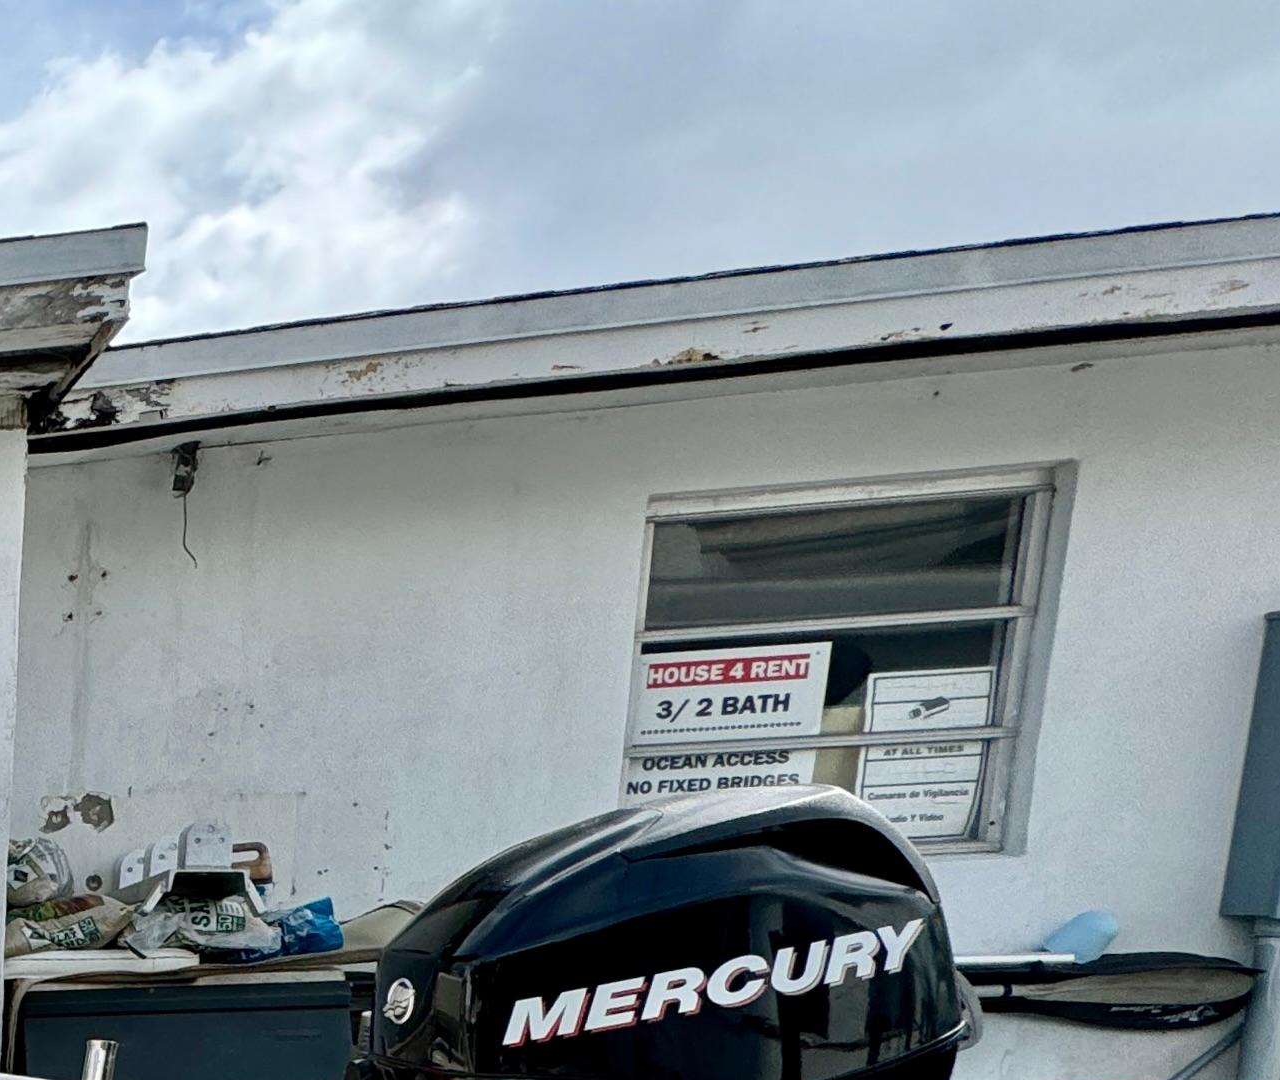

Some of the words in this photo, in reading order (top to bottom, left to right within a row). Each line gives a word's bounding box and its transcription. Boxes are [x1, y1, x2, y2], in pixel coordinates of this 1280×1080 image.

[647, 663, 725, 685] HOUSE
[728, 662, 745, 679] 4
[749, 657, 811, 679] RENT
[695, 698, 713, 717] 2
[720, 692, 791, 716] BATH
[642, 754, 708, 772] OCEAN
[712, 749, 790, 768] ACCESS
[883, 747, 900, 757] AT
[902, 746, 922, 756] ALL
[927, 744, 964, 755] TIMES
[626, 780, 652, 795] NO
[657, 777, 712, 793] FIXED
[716, 773, 800, 789] BRIDGES
[923, 786, 969, 799] Vigilancia
[889, 814, 907, 823] udio
[502, 918, 926, 1048] MERCURY
